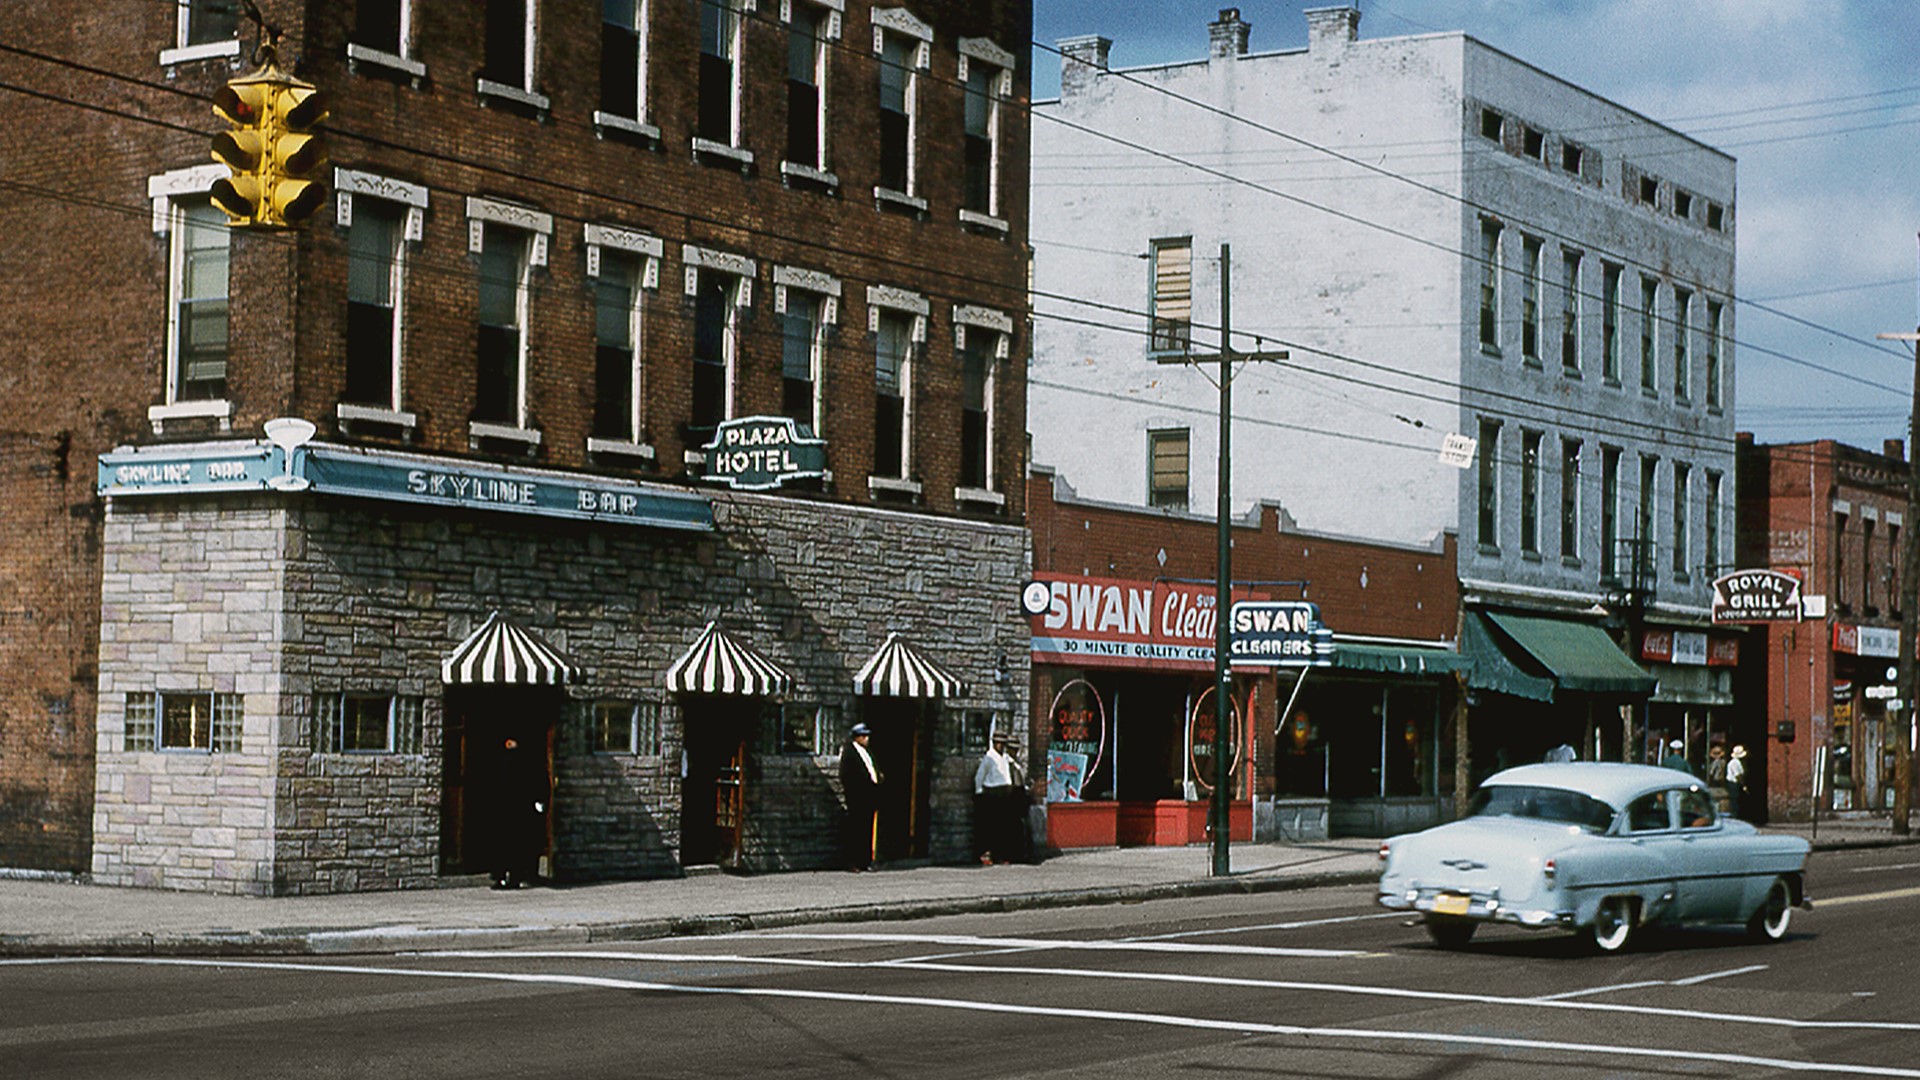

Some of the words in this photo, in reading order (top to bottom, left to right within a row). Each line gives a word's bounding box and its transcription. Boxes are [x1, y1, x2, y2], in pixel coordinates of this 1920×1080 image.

[726, 426, 790, 446] PLAZA
[716, 449, 798, 474] HOTEL
[116, 463, 191, 484] SKYLINE
[206, 461, 247, 481] BAR
[408, 470, 537, 504] SKYLINE
[577, 489, 638, 515] BAR
[1727, 575, 1783, 593] ROYAL
[1045, 581, 1152, 636] SWAN
[1730, 594, 1781, 609] GRILL
[1236, 609, 1309, 633] SWAN
[1063, 640, 1078, 652] 30
[1085, 642, 1128, 655] MINUTE
[1135, 645, 1181, 658] QUALITY
[1187, 648, 1216, 660] CLEA
[1230, 639, 1313, 655] CLEANERS
